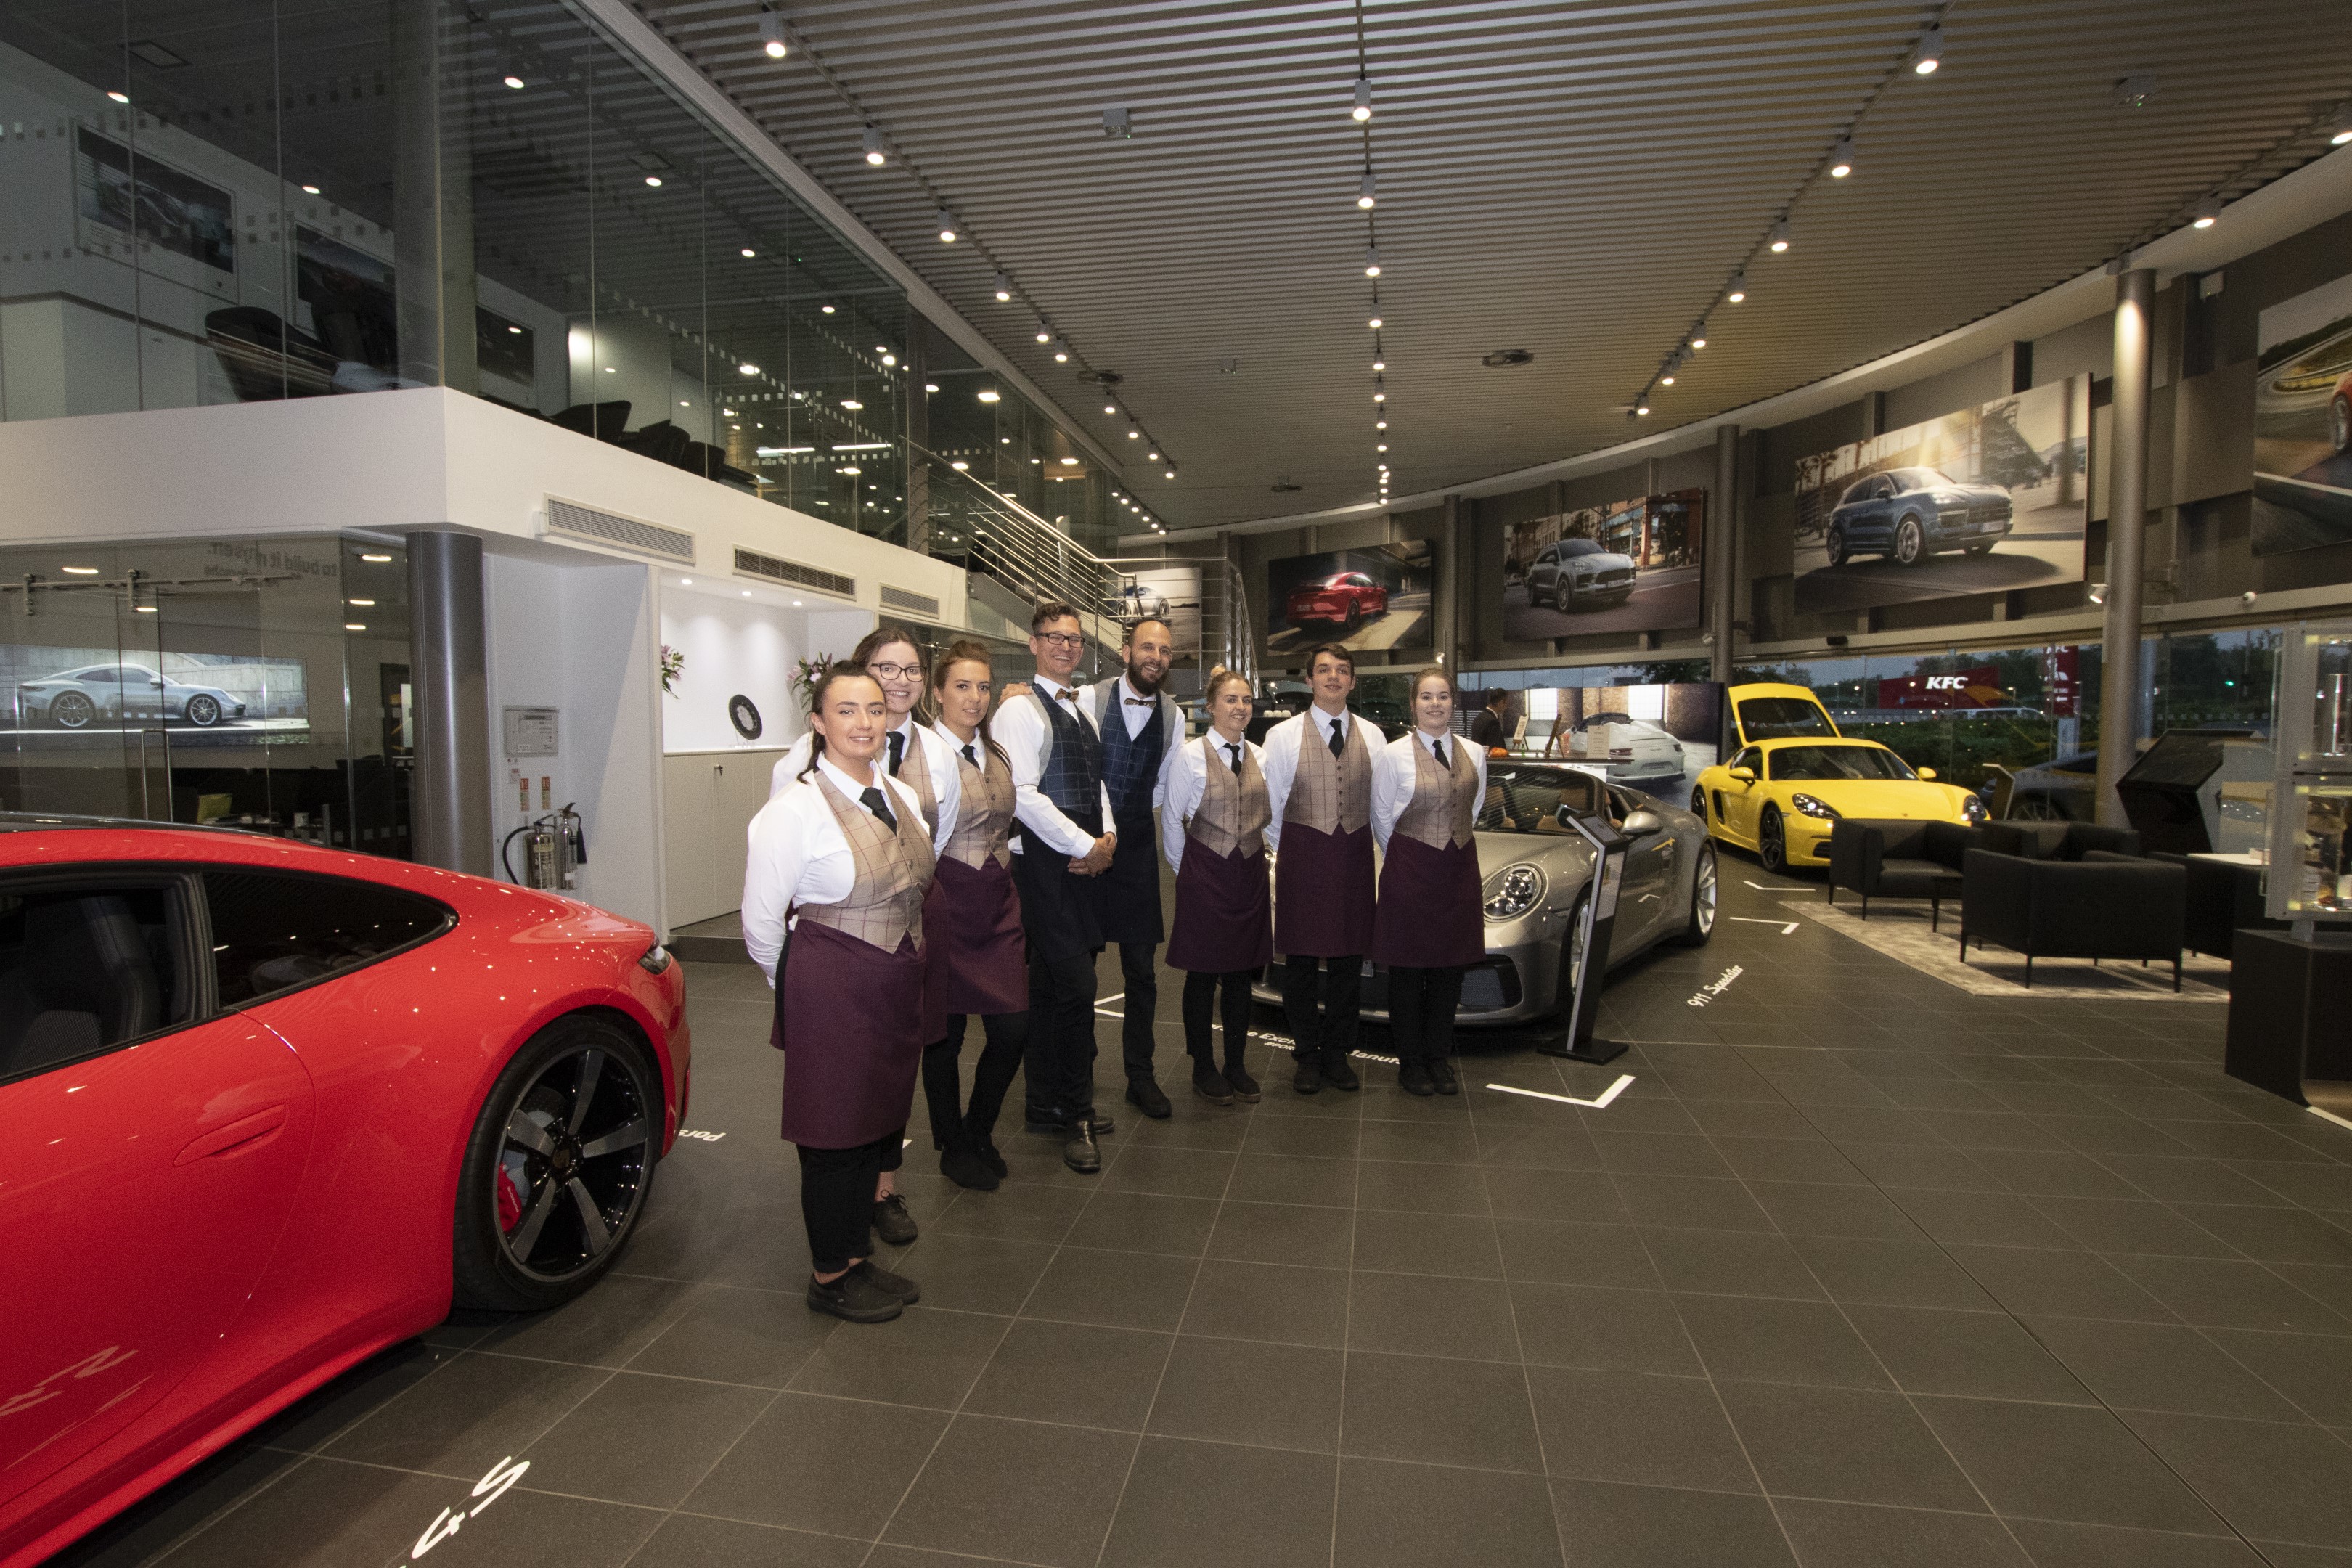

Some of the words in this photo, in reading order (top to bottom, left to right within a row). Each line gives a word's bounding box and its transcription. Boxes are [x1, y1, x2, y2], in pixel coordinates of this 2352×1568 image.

[1925, 676, 1969, 690] KFC
[1687, 992, 1712, 1007] 911
[1258, 1032, 1296, 1045] Excl
[1349, 1050, 1400, 1064] anuf
[1264, 1041, 1296, 1051] #POR
[678, 1129, 726, 1141] Pors
